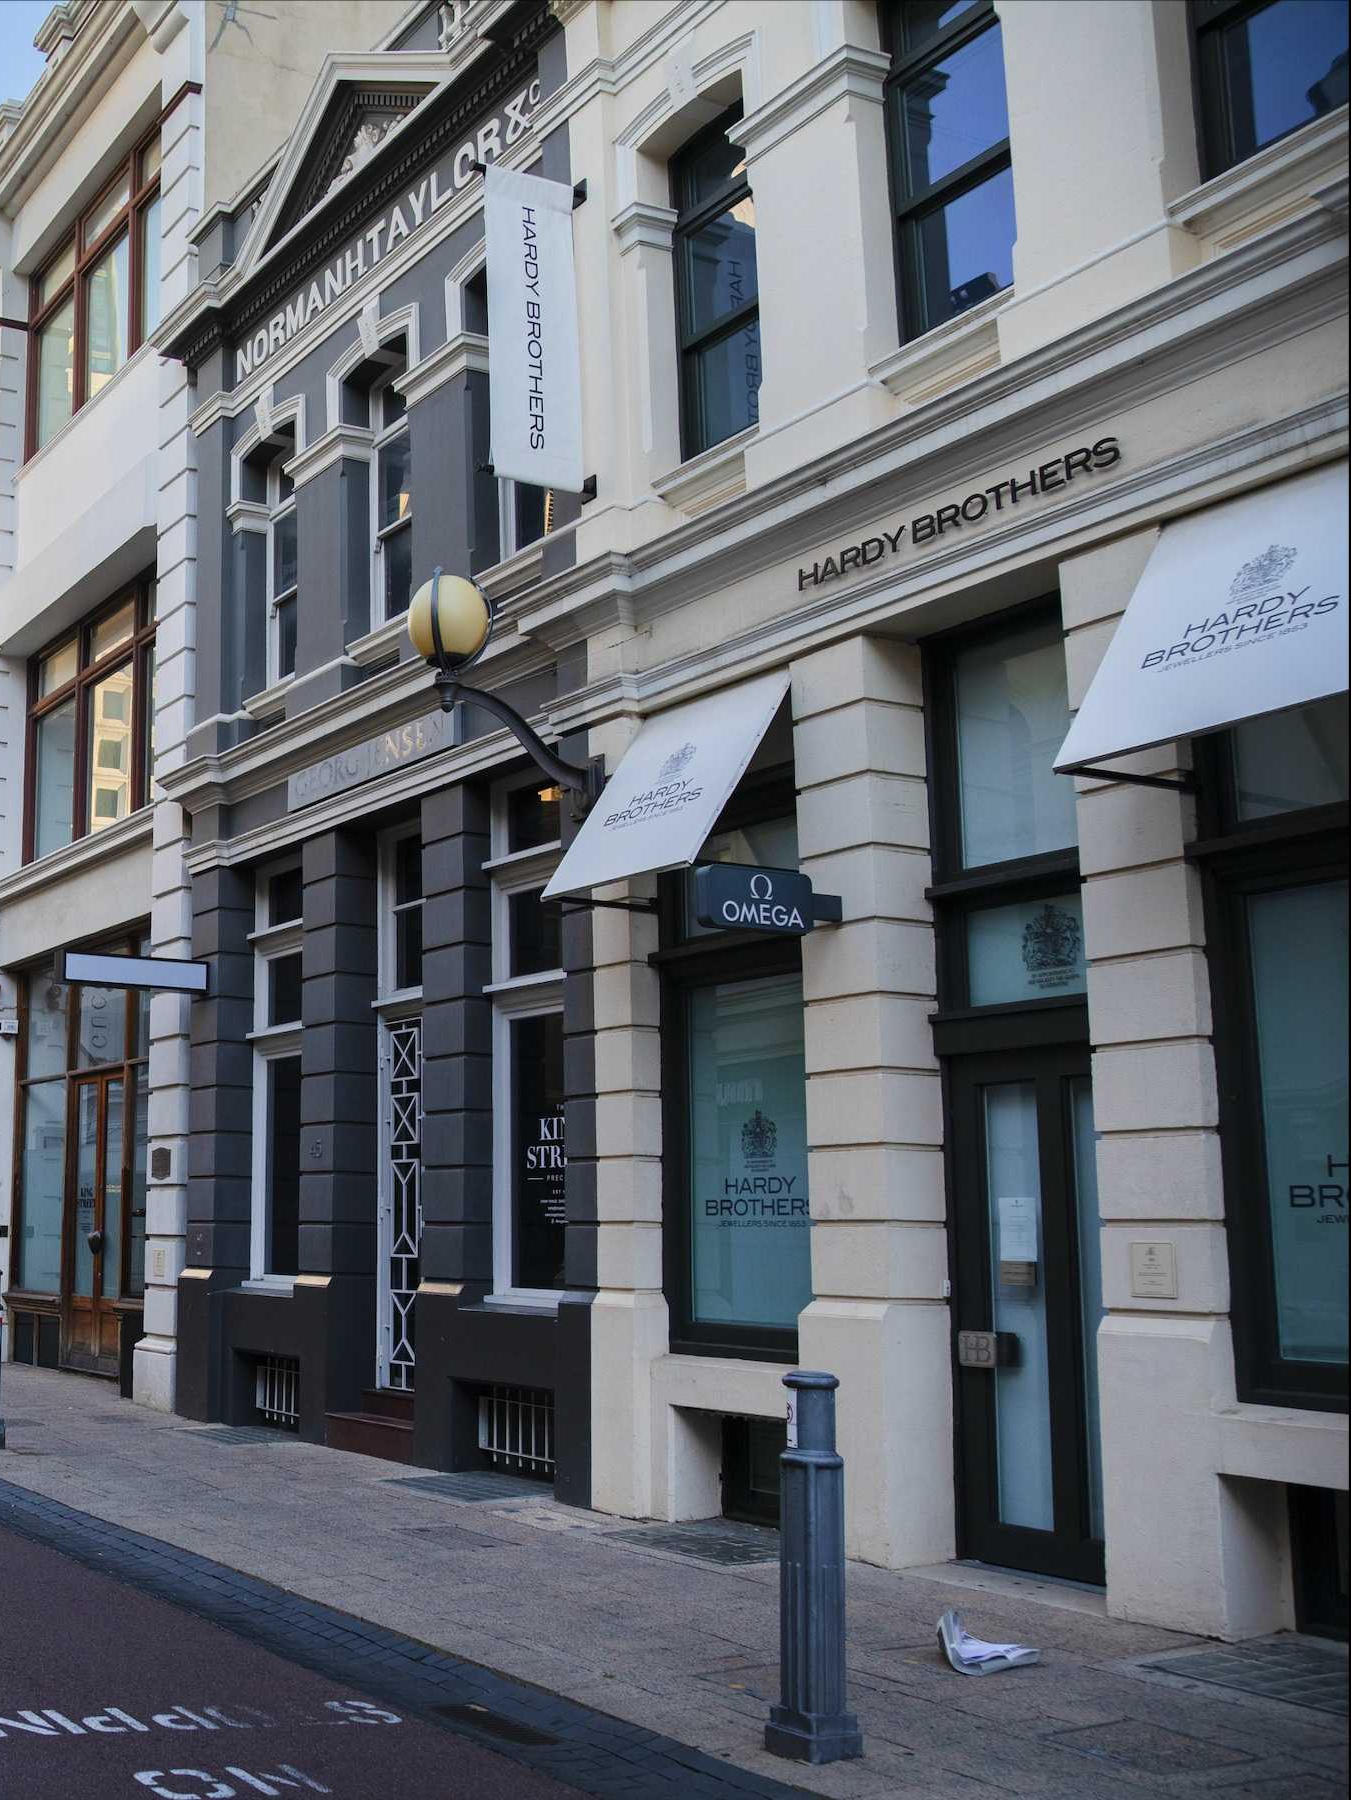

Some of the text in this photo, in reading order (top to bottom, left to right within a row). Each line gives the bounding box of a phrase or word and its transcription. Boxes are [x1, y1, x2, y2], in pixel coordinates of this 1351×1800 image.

[236, 258, 344, 383] NORMAN
[366, 117, 503, 264] TAYLOR
[522, 206, 545, 450] HARDY BROTHERS
[798, 437, 1122, 591] HARDY BROTHERS
[1141, 595, 1341, 669] BROTHERS
[1183, 585, 1311, 639] HARDY
[1157, 646, 1233, 673] JEWELLERS
[1234, 632, 1275, 650] SINCE
[603, 787, 704, 827] BROTHERS
[629, 777, 694, 807] HARDY
[722, 900, 804, 929] OMEGA
[527, 1145, 568, 1169] STR
[725, 1176, 797, 1194] HARDY
